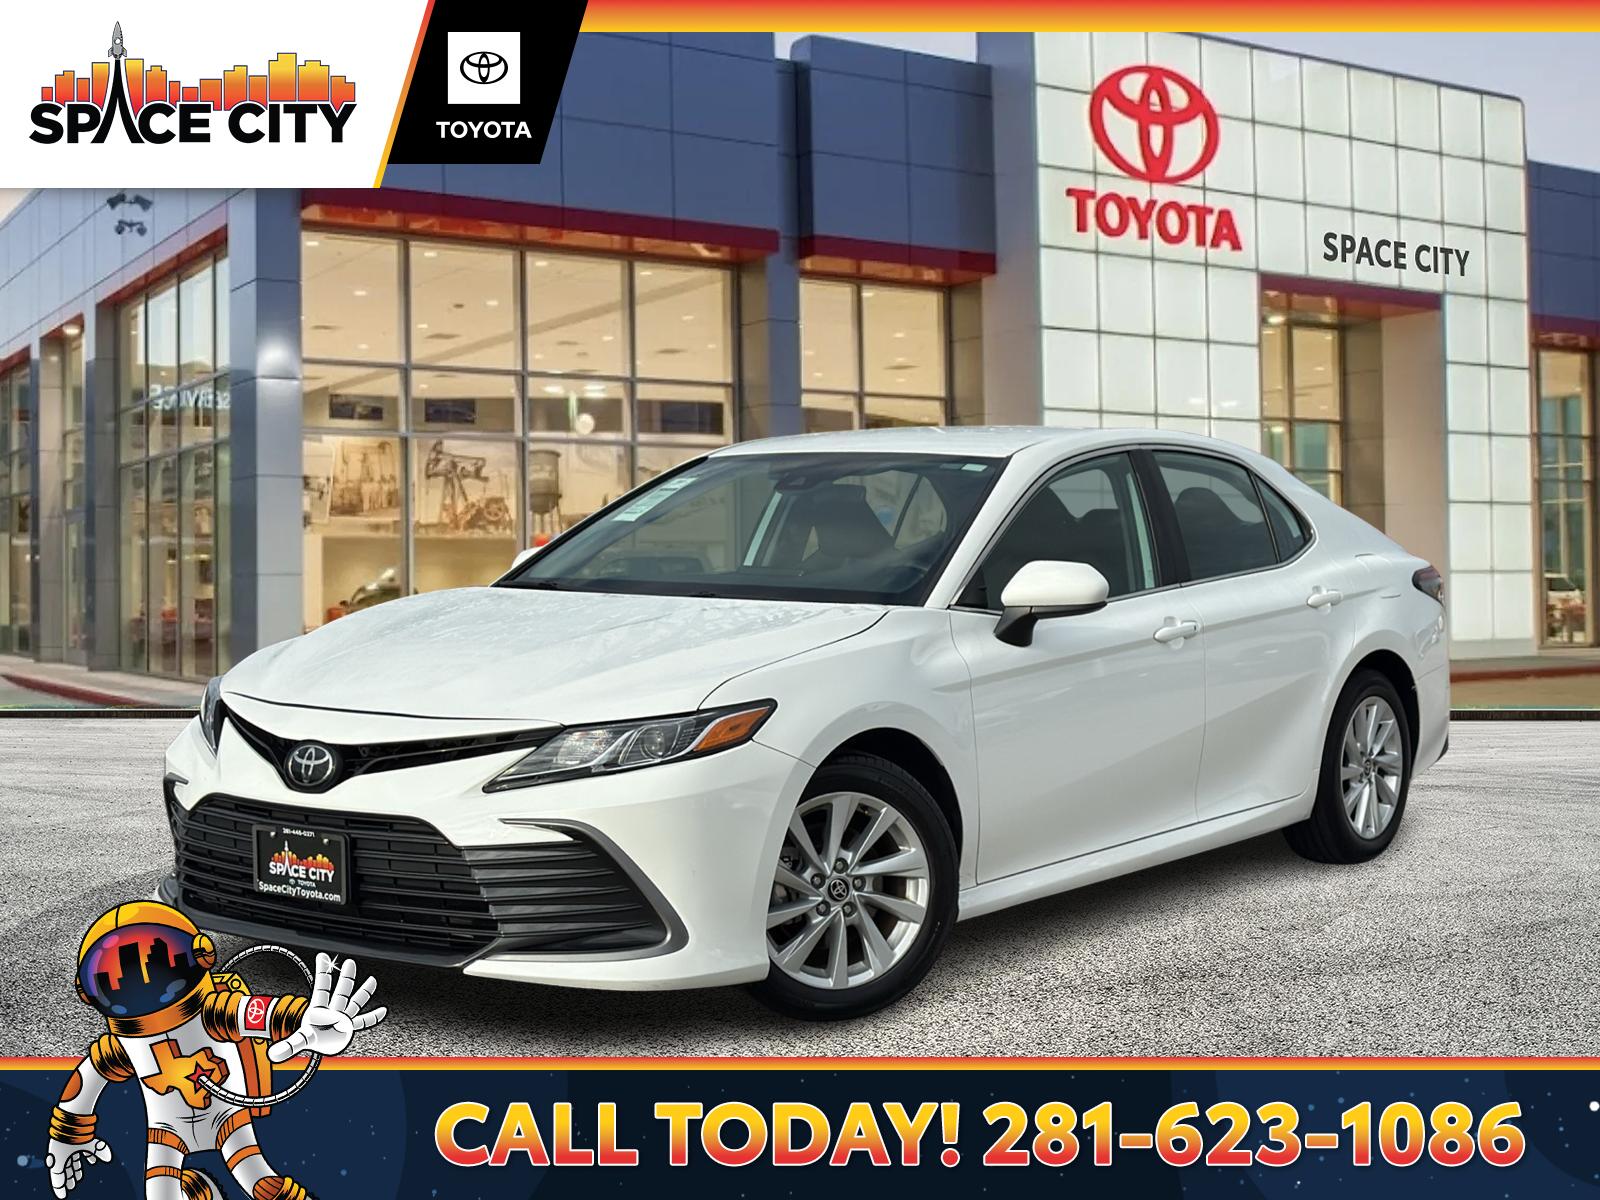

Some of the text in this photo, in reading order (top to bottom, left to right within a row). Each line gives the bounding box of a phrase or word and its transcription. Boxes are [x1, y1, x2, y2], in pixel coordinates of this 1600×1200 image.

[1066, 188, 1242, 251] TOYOTA
[1323, 232, 1471, 277] SPACE CITY
[298, 880, 316, 888] TOYOTA
[308, 867, 335, 883] CITY
[259, 881, 341, 902] SpaceCityToyota.com
